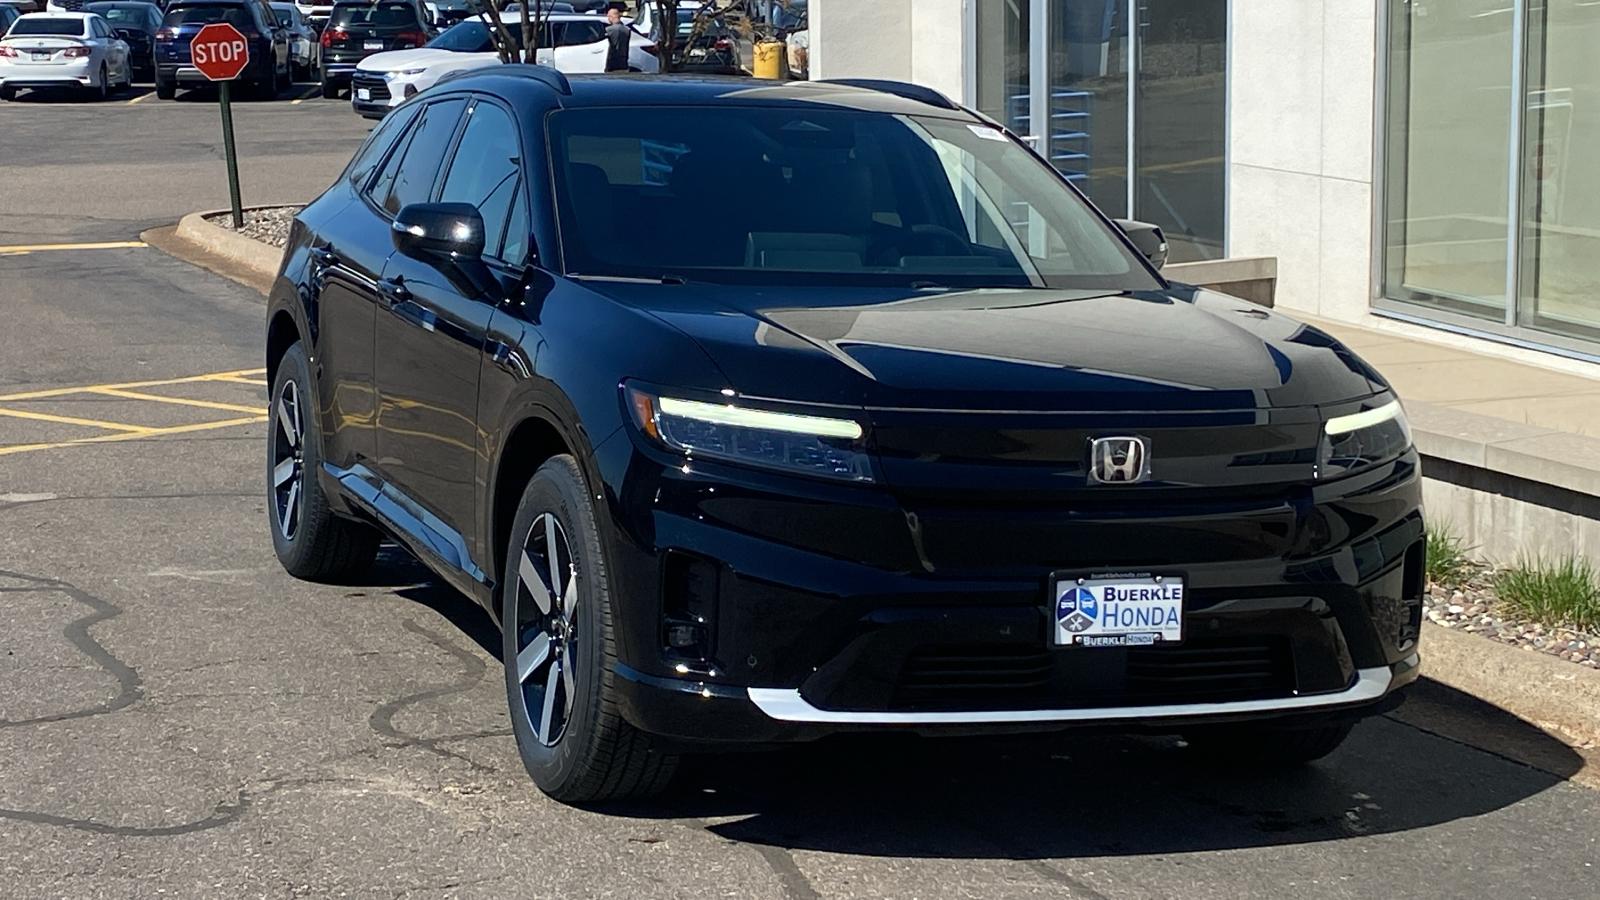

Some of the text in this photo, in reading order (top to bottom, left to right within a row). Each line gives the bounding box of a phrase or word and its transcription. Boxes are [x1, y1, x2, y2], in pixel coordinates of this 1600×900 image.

[195, 40, 244, 64] STOP
[1104, 587, 1181, 601] BUERKLE
[1102, 603, 1179, 627] HONDA
